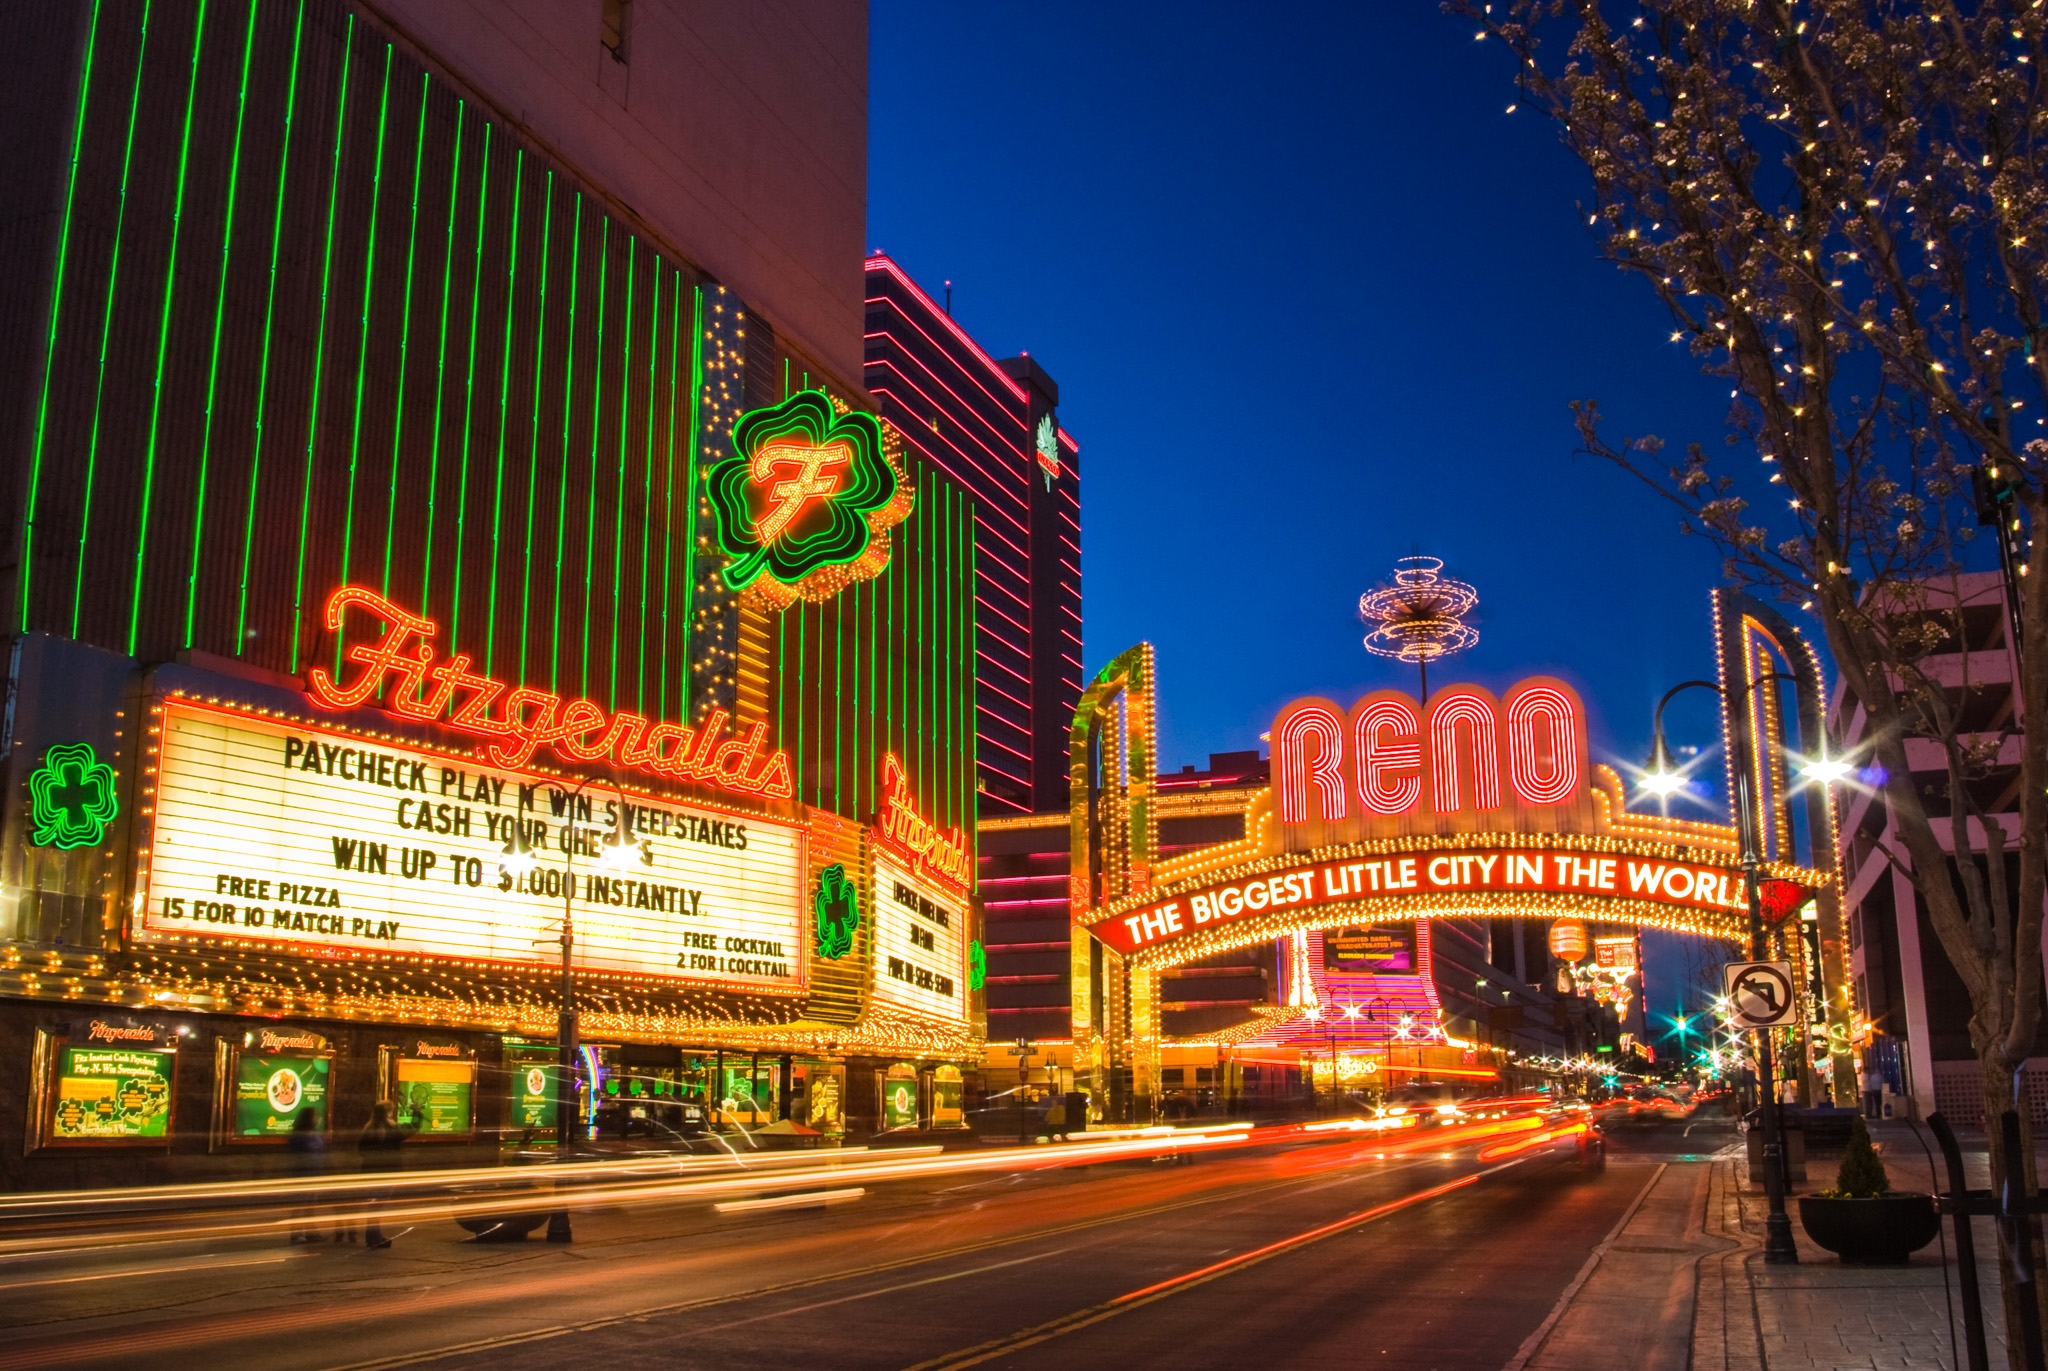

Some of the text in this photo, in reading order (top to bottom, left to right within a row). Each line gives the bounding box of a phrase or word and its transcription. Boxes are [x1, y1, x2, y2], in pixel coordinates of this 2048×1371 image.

[750, 444, 849, 545] F
[311, 586, 794, 798] Fitzgeralds
[284, 736, 428, 794] PAYCHECK
[440, 767, 506, 807] PLAY
[397, 797, 471, 838] CASH
[484, 811, 548, 850] YOUR
[881, 753, 971, 890] Fitzgeralds
[216, 874, 342, 909] FREE PIZZA
[332, 836, 388, 875] WIN
[401, 847, 437, 881] UP
[450, 854, 483, 888] TO
[586, 875, 702, 917] INSTANTLY
[1125, 902, 1183, 945] THE
[1191, 868, 1317, 922] BIGGEST
[1324, 857, 1418, 898] LITTLE
[1427, 853, 1499, 885] CITY
[1505, 853, 1544, 885] IN
[1554, 854, 1617, 890] THE
[162, 897, 401, 941] 15 FOR 10 MATCH PLAY
[676, 952, 686, 969] 2
[690, 953, 717, 971] FOR
[728, 957, 791, 979] COCKTAIL
[683, 931, 786, 958] FREE COCKTAIL
[89, 1019, 155, 1044] Fitzgeralds
[73, 1064, 90, 1075] Play
[102, 1064, 117, 1074] Win
[89, 1052, 113, 1063] Instant
[113, 1052, 130, 1063] Cash
[130, 1054, 159, 1067] Paycheck
